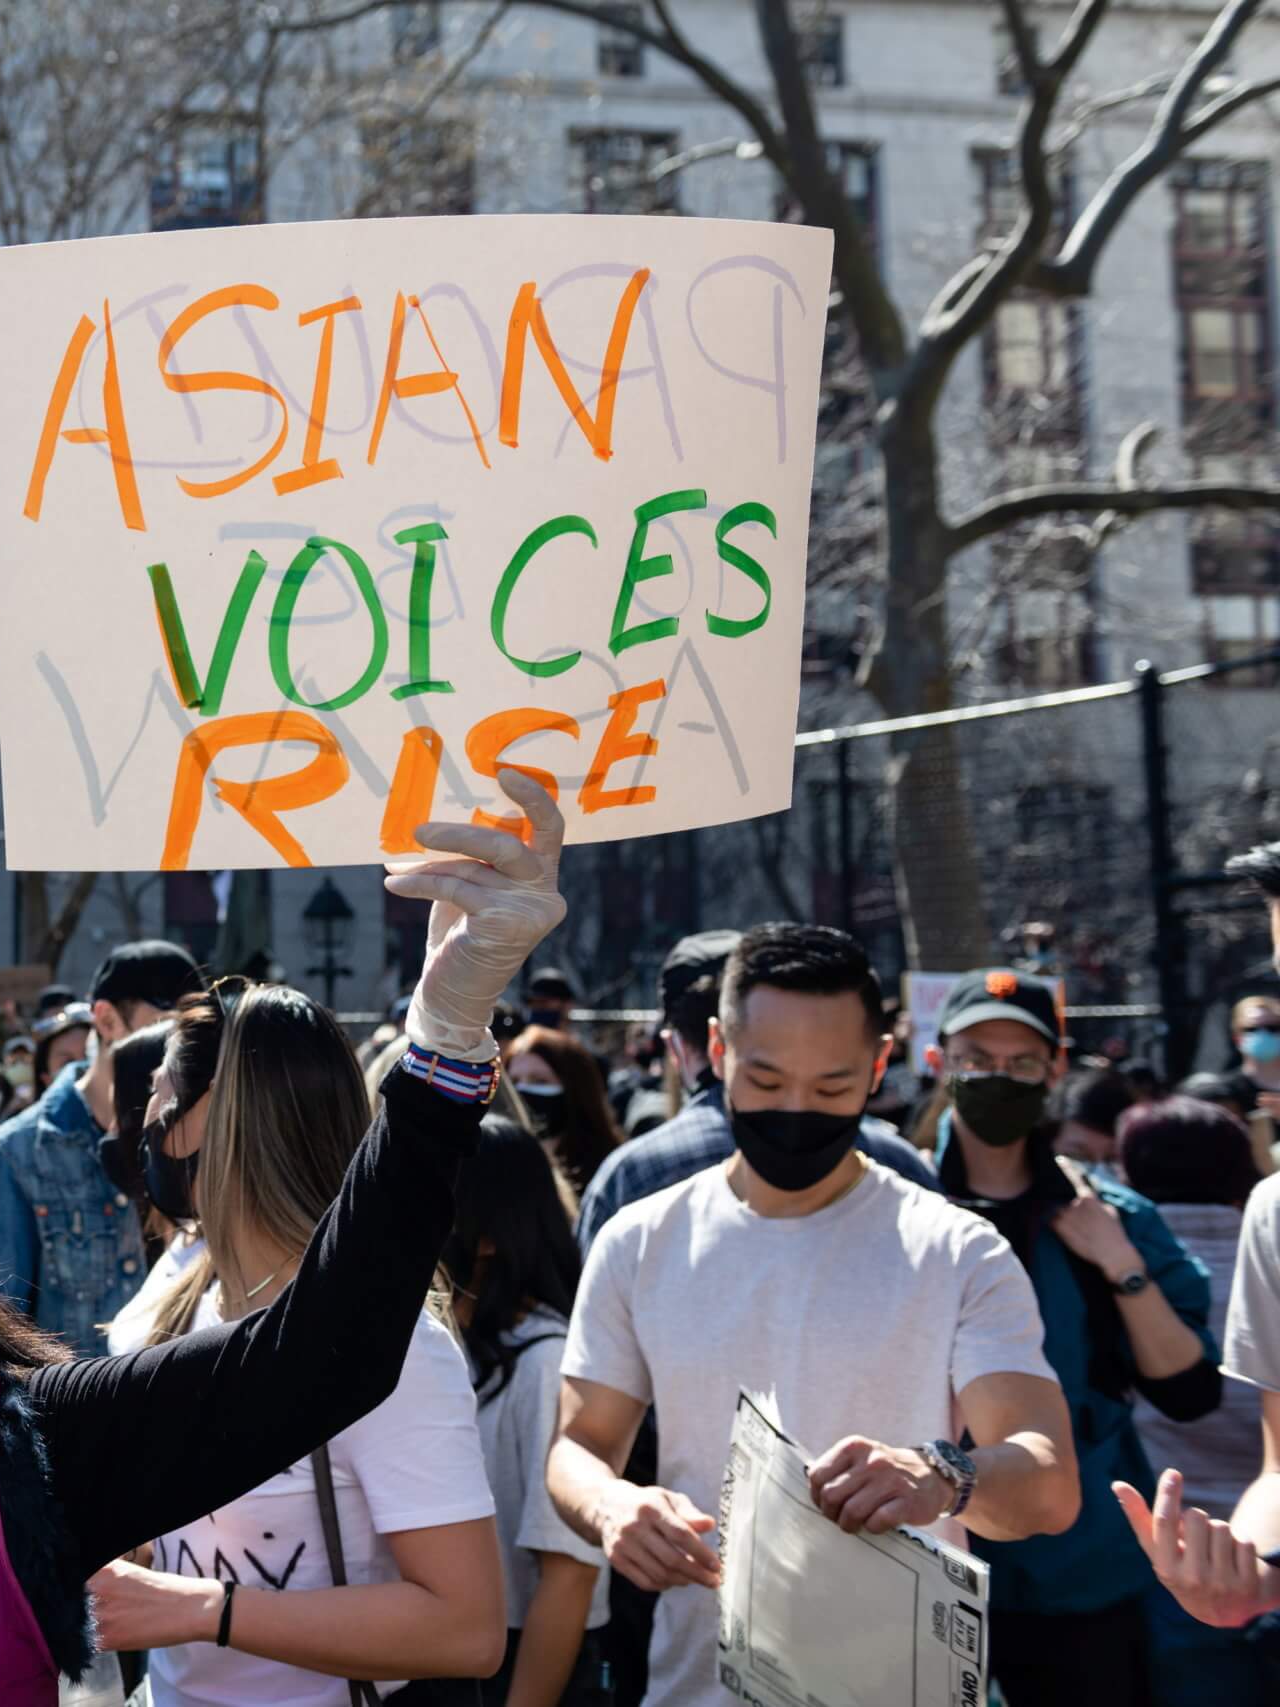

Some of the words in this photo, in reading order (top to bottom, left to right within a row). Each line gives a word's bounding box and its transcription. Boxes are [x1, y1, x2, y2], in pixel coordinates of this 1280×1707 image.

[23, 268, 650, 532] ASIAN
[147, 488, 777, 717] VOICES
[159, 678, 667, 871] RISE
[967, 1625, 976, 1653] WHITE
